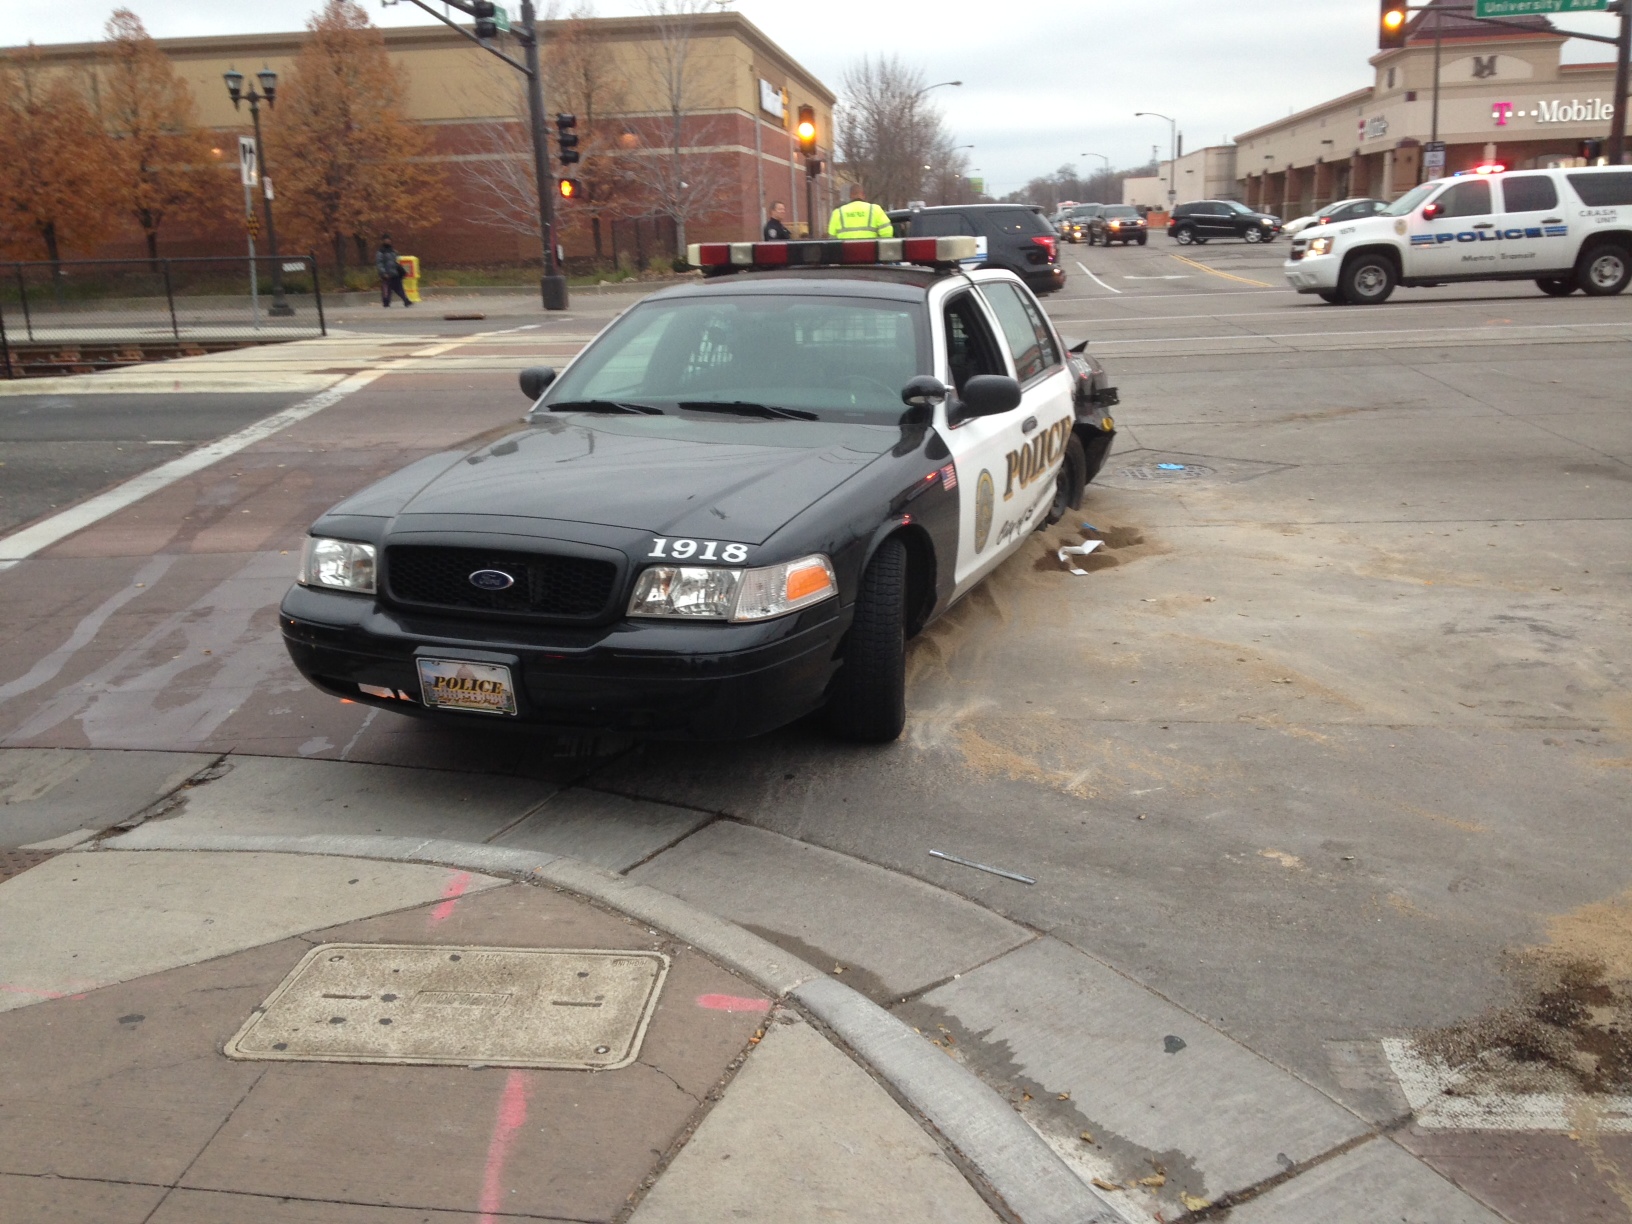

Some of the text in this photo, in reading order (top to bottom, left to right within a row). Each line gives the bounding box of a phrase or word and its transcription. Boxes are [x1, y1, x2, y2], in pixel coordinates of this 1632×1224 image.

[1484, 0, 1562, 13] University
[1434, 227, 1545, 244] POLICE
[1460, 252, 1537, 262] Metro Transit
[647, 538, 749, 563] 1918
[432, 676, 504, 696] POLICE
